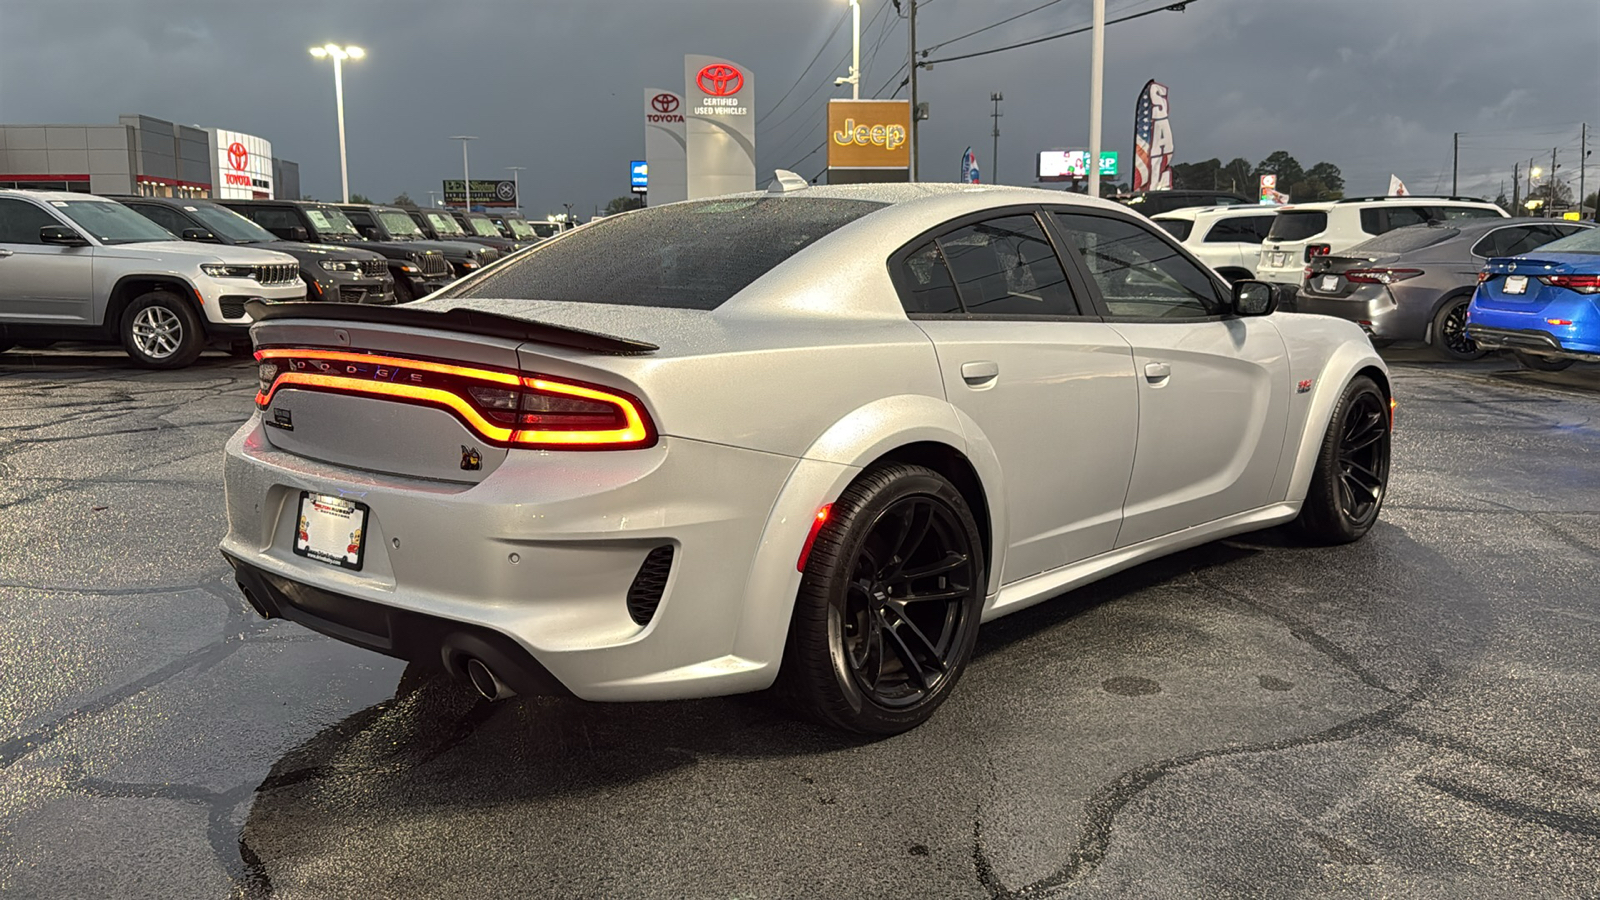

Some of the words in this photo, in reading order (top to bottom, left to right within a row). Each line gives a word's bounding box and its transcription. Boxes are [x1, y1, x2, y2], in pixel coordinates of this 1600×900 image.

[703, 98, 738, 106] CERTIFIED
[714, 107, 747, 115] VEHICLES
[647, 114, 685, 123] TOYOTA
[833, 118, 906, 150] Jeep
[1149, 82, 1174, 192] SAL
[224, 173, 253, 187] TOYOTA
[297, 361, 423, 382] DODGE
